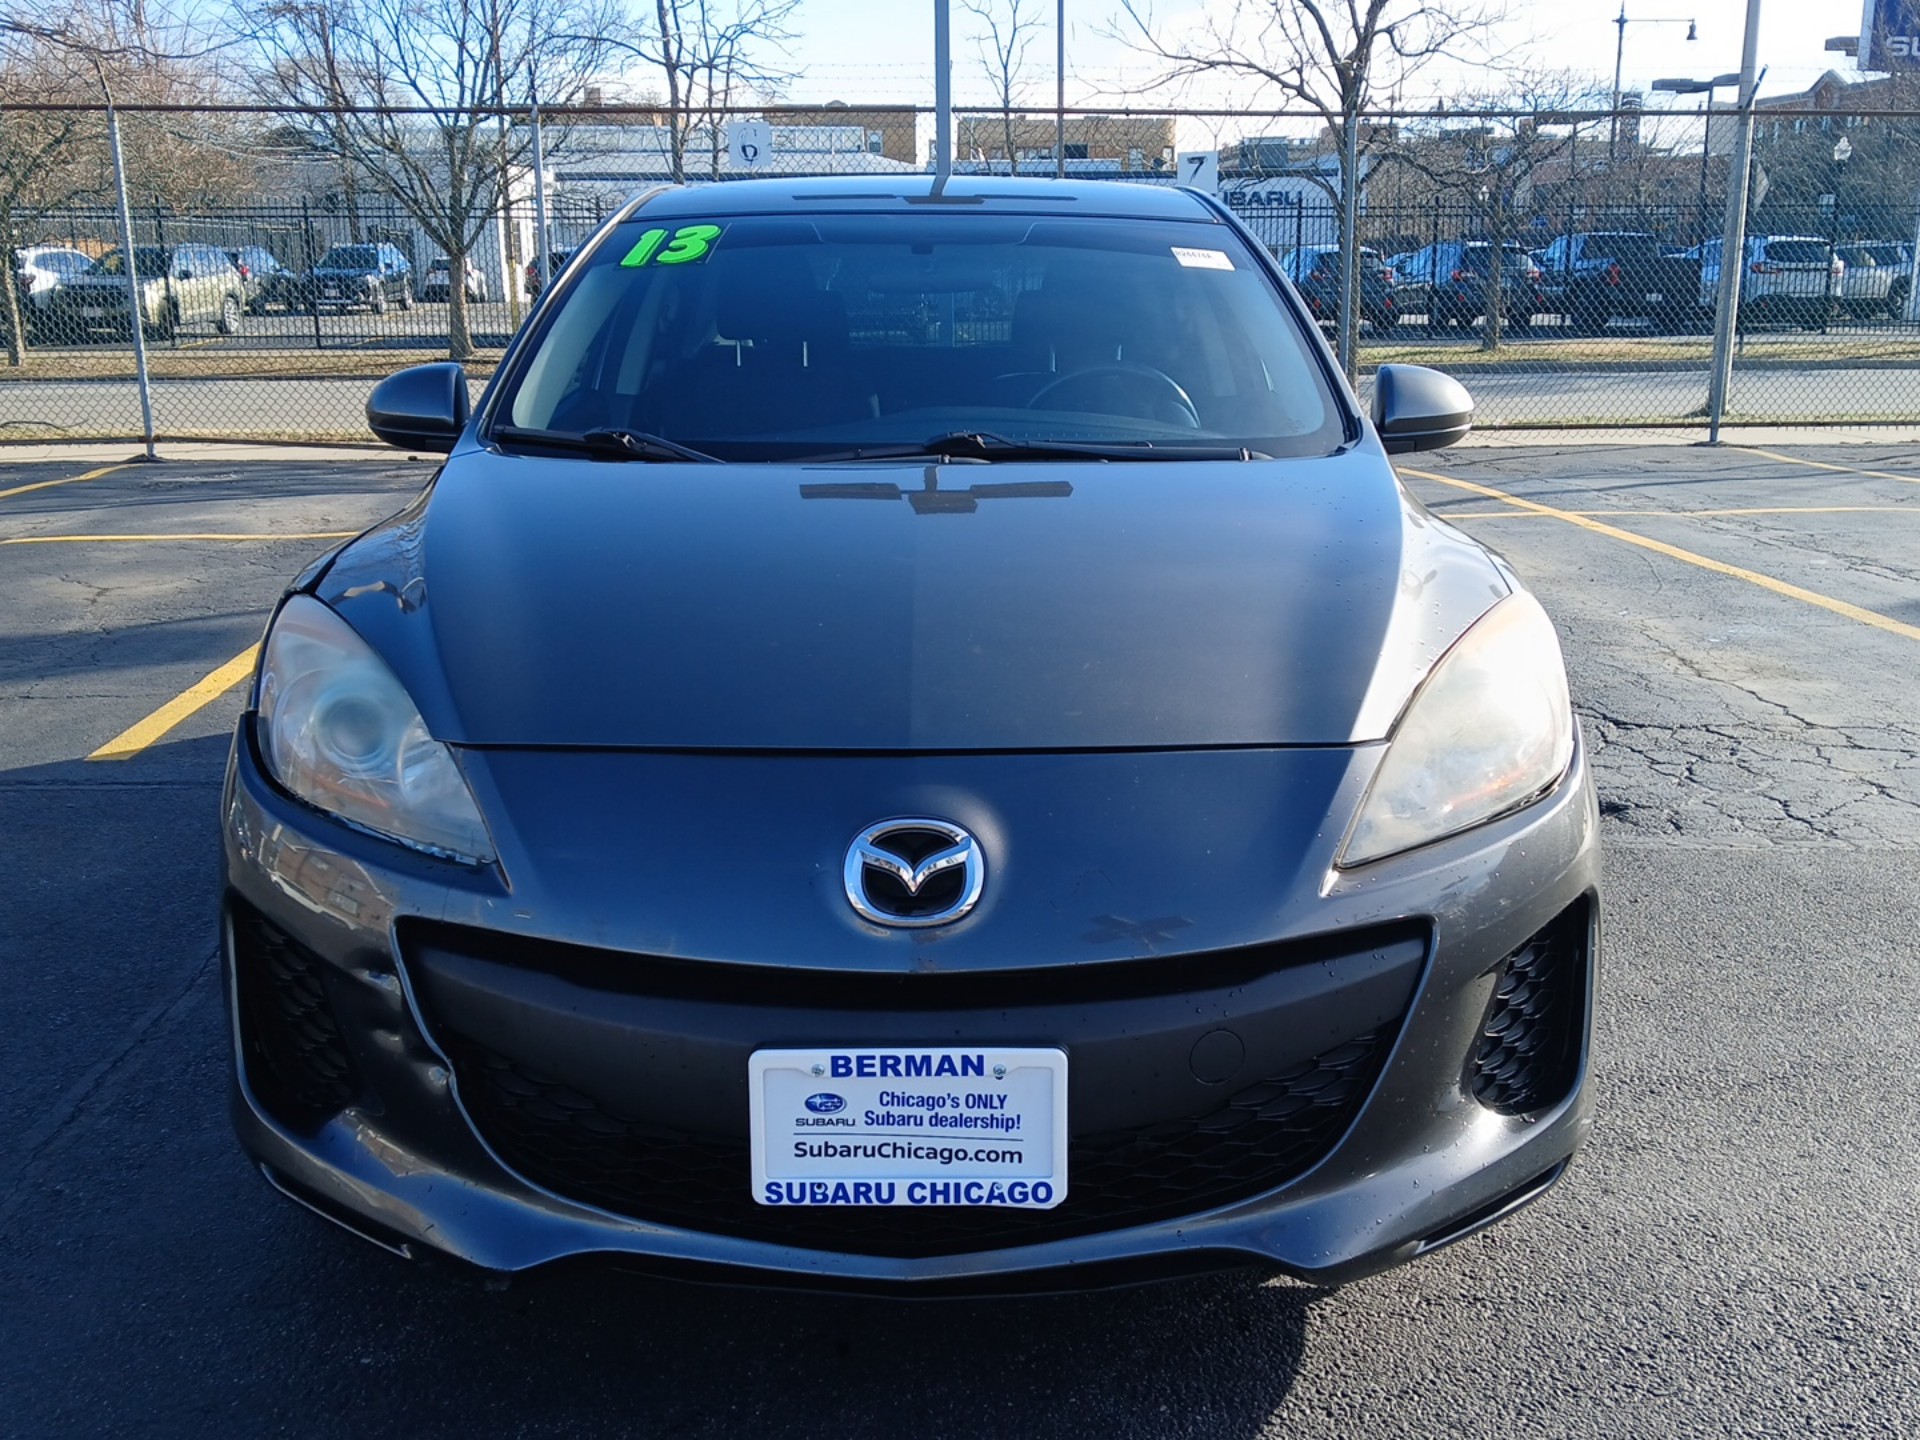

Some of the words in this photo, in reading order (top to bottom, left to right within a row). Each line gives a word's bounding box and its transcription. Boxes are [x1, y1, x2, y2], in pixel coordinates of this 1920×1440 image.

[1186, 155, 1208, 185] 7
[620, 225, 721, 267] 13
[830, 1055, 985, 1078] BERMAN
[879, 1091, 960, 1111] Chicago's
[965, 1093, 1008, 1110] ONLY
[795, 1118, 856, 1127] SUBARU
[864, 1110, 923, 1127] Subaru
[928, 1112, 1021, 1133] dealership!
[794, 1141, 1023, 1165] SubaruChicago.com
[765, 1181, 896, 1204] SUBARU
[907, 1181, 1053, 1205] CHICAGO
